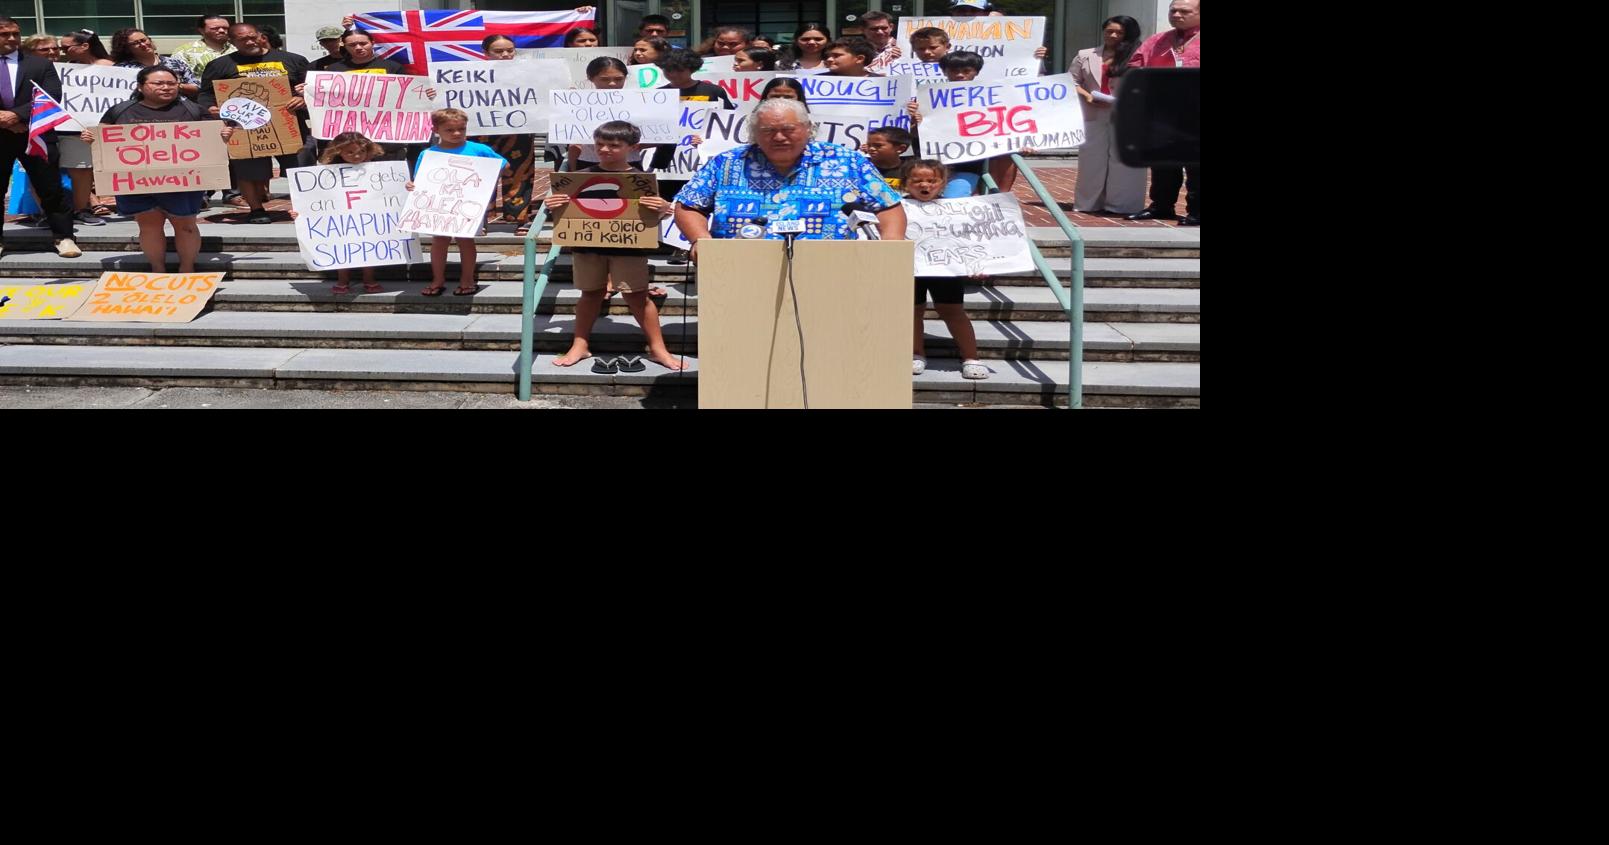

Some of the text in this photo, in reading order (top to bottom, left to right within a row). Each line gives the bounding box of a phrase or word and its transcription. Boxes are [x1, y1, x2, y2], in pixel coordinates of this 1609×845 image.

[436, 69, 495, 84] KEIKI
[890, 62, 943, 77] KEEP!
[313, 73, 414, 109] EQUITY
[445, 87, 538, 109] PUNANA
[553, 91, 667, 106] NO CUTS TO
[929, 85, 1003, 110] WERE
[321, 109, 434, 141] HAWAIIAN
[476, 109, 528, 128] LEO
[956, 105, 1038, 138] BIG
[102, 126, 126, 143] E
[130, 125, 167, 142] Ola
[256, 134, 269, 142] KA
[926, 140, 986, 161] 400
[112, 169, 201, 192] Hawai'i
[369, 166, 406, 191] gets
[310, 189, 401, 212] an F in
[439, 183, 465, 198] KA
[306, 211, 407, 240] KAIAPUN
[558, 231, 567, 240] a
[574, 230, 593, 242] nā
[312, 238, 416, 268] SUPPORT
[88, 292, 112, 304] 2
